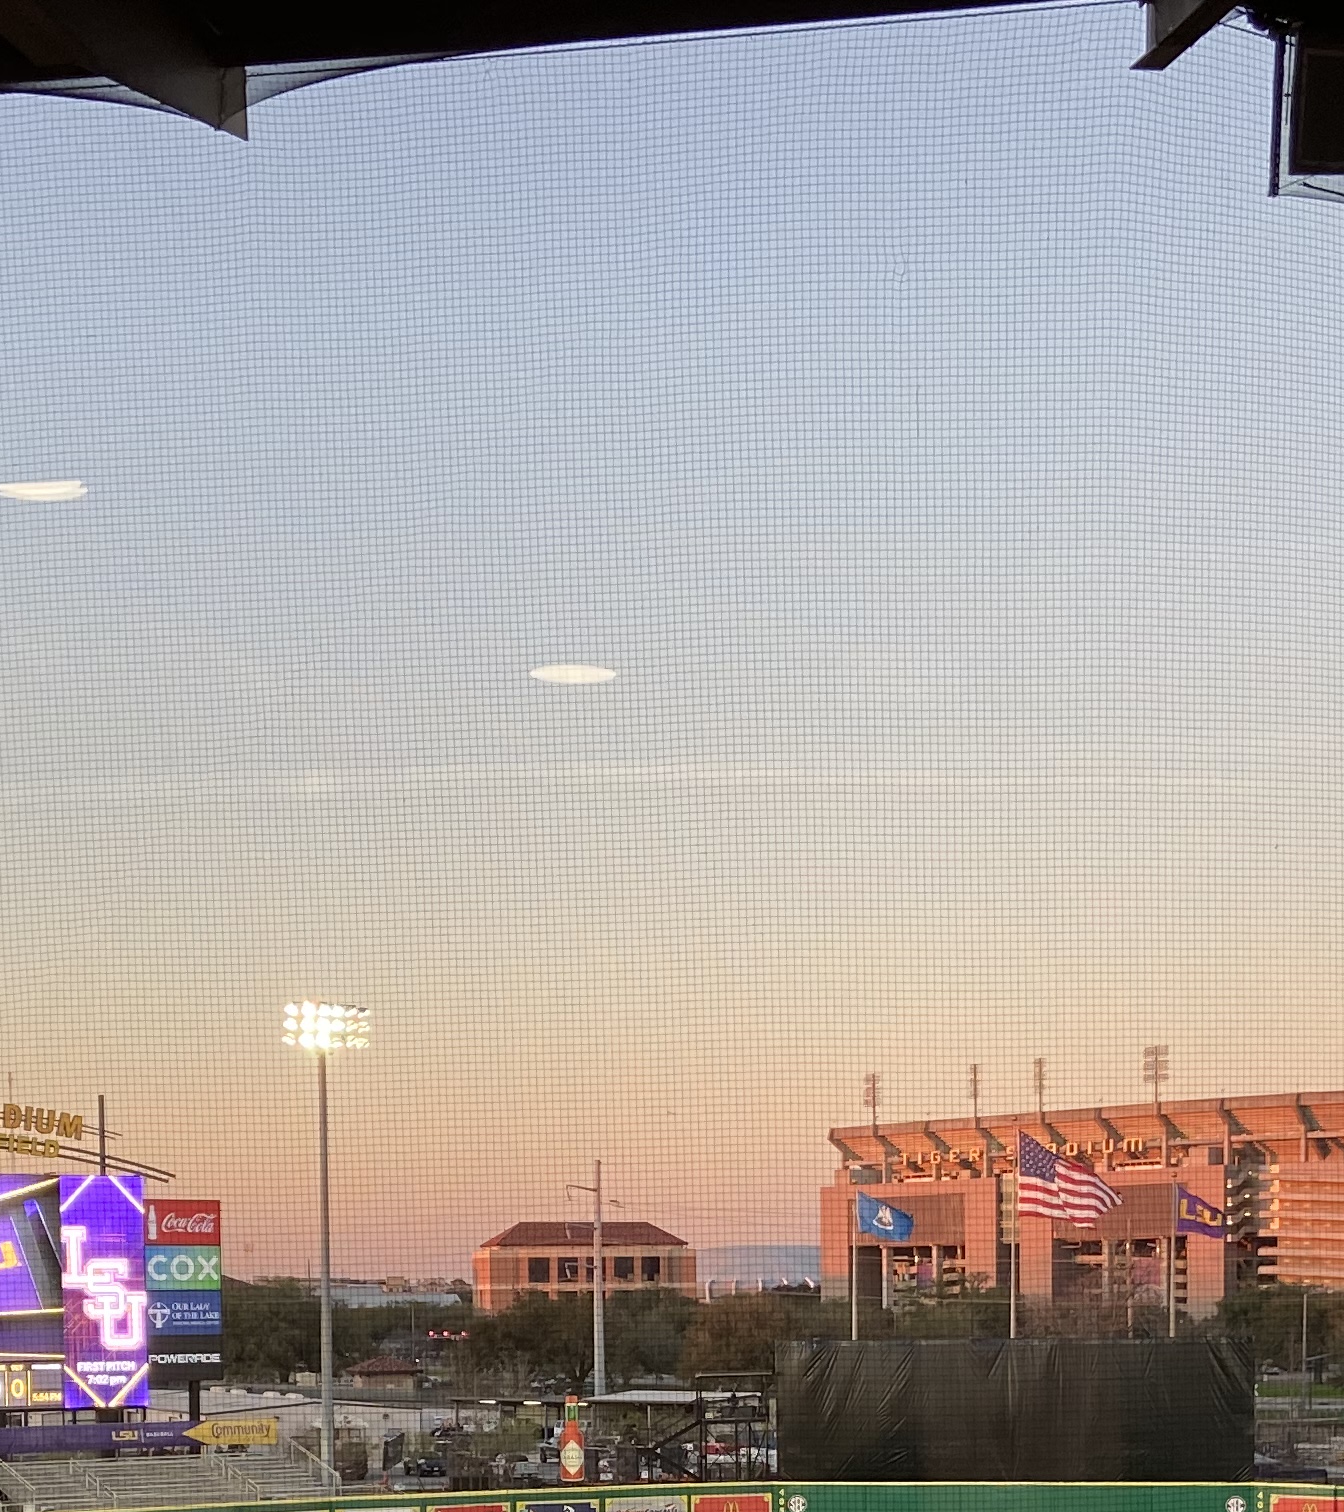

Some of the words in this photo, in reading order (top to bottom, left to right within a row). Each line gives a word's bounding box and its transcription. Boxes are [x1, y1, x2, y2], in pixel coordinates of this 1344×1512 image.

[900, 1149, 981, 1165] TIGER
[1008, 1137, 1144, 1160] SADIUM
[147, 1254, 220, 1281] COX
[60, 1225, 148, 1350] LSU
[172, 1302, 189, 1310] OUR
[190, 1301, 210, 1311] LADY
[200, 1311, 219, 1319] LAKE
[149, 1353, 221, 1364] POWERADE
[77, 1362, 105, 1373] FIRST
[106, 1361, 135, 1372] PITCH
[110, 1376, 127, 1386] pm
[10, 1378, 25, 1399] 0
[111, 1430, 139, 1441] LSU
[211, 1422, 271, 1439] Community
